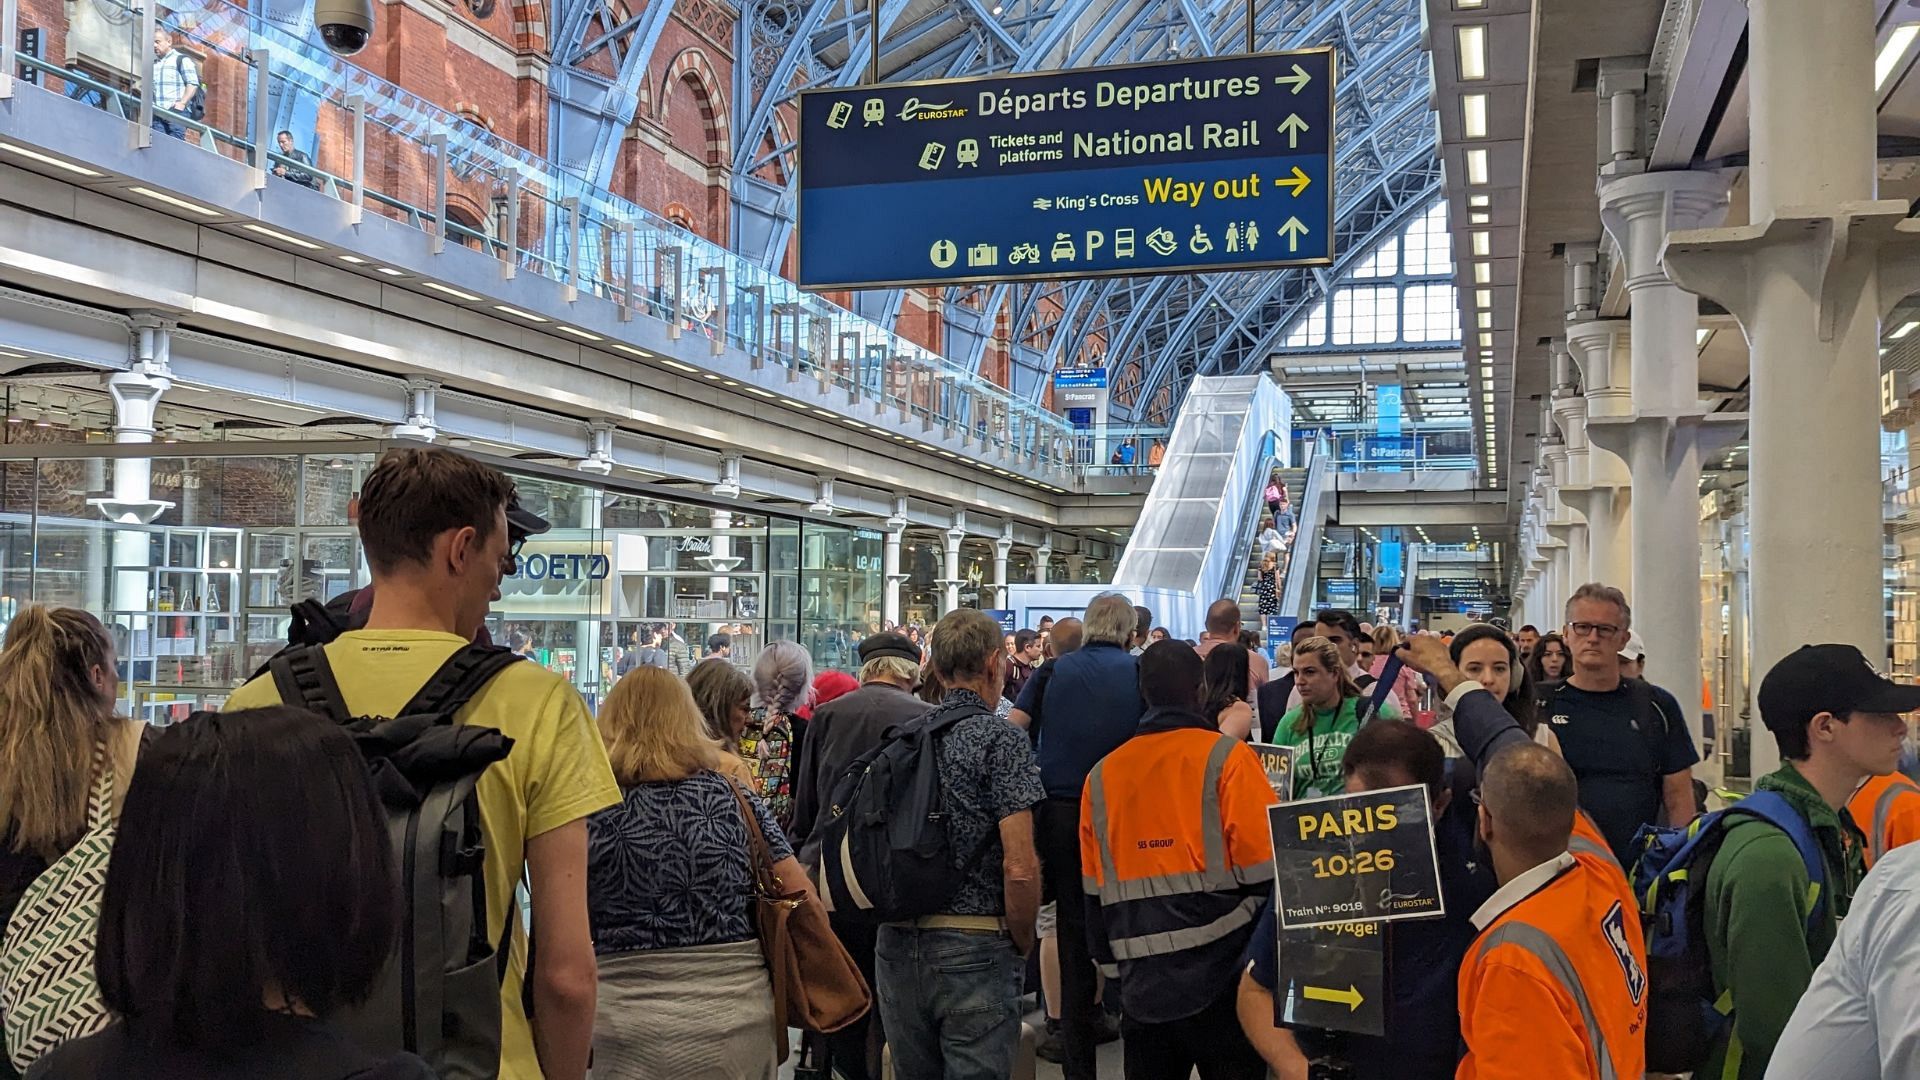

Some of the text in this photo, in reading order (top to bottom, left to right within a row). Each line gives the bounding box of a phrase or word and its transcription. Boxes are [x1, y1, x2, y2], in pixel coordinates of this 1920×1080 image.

[978, 89, 1087, 120] Départs
[1096, 76, 1261, 111] Departures
[989, 131, 1063, 149] Tickets and
[1073, 120, 1260, 159] National Rail
[999, 147, 1063, 167] platforms
[1143, 173, 1260, 208] Way out
[1056, 194, 1139, 212] King's Cross
[1260, 753, 1289, 775] ARIS
[1298, 804, 1398, 841] PARIS
[1149, 838, 1174, 848] GROUP
[1311, 849, 1395, 878] 10:26
[1286, 907, 1313, 918] Train
[1333, 901, 1363, 913] 9018
